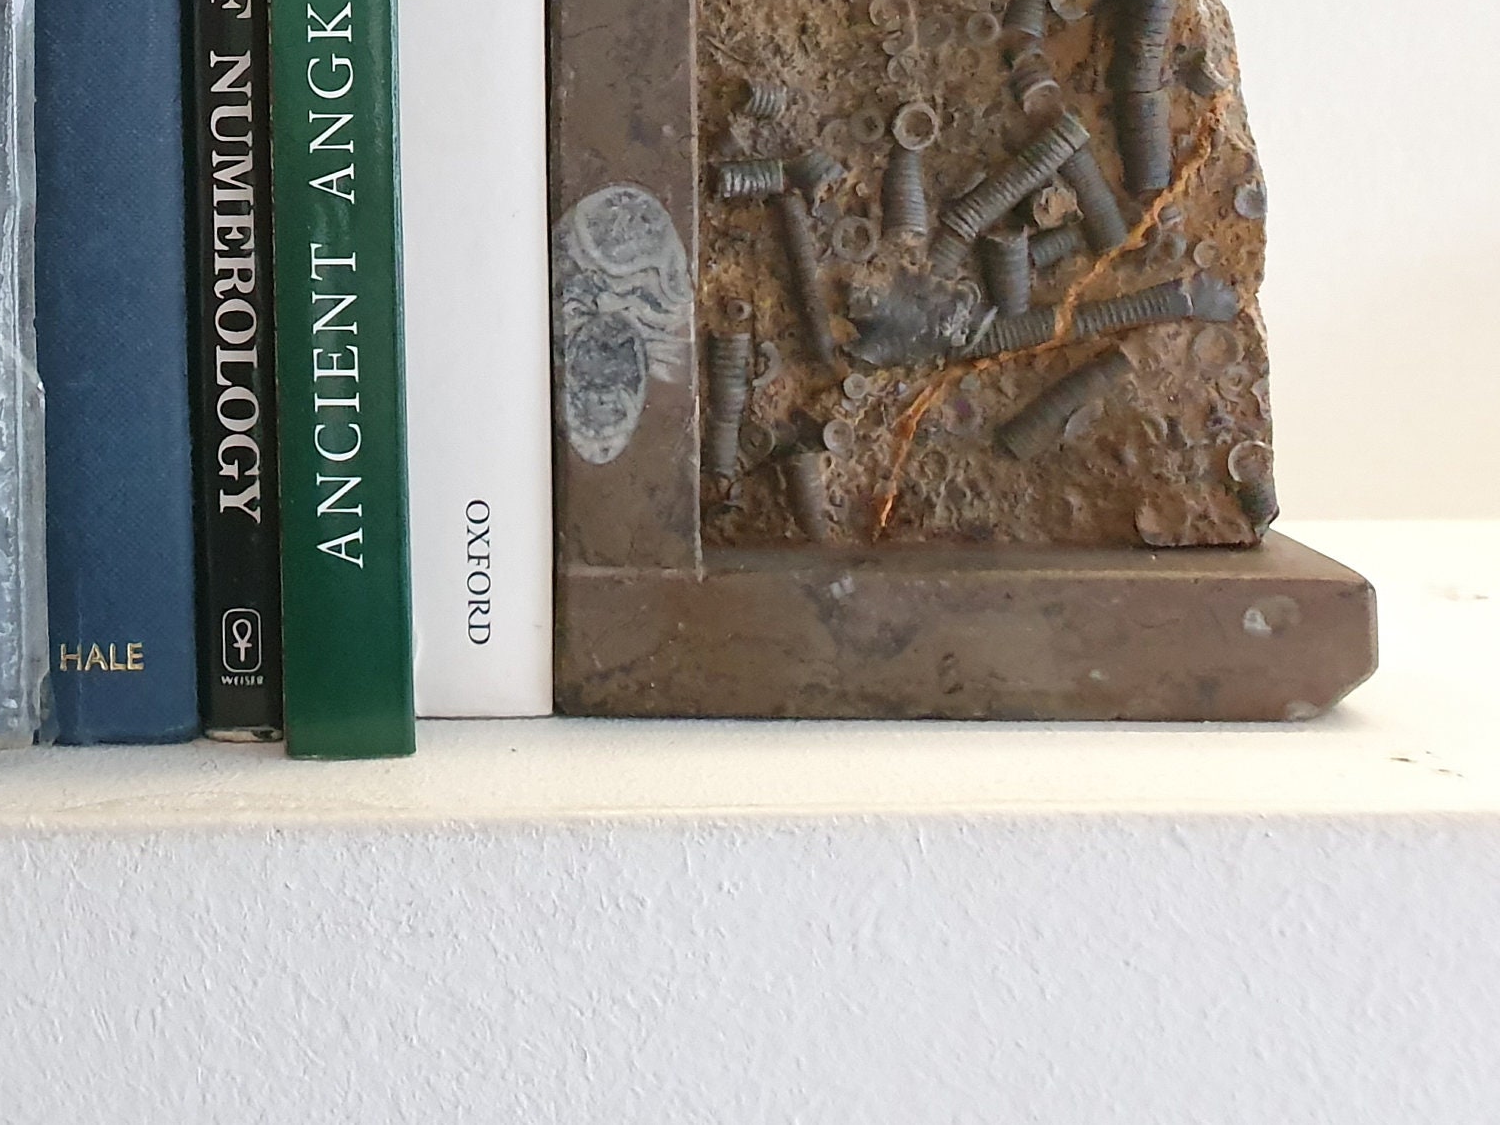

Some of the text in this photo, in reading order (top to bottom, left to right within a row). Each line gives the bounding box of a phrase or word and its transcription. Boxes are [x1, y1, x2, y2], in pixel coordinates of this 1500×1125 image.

[208, 48, 263, 526] NUMEROLOGY
[309, 242, 364, 569] ANCIENT
[465, 498, 492, 646] OXFORD
[58, 642, 145, 672] HALE
[221, 675, 264, 686] WEISER
